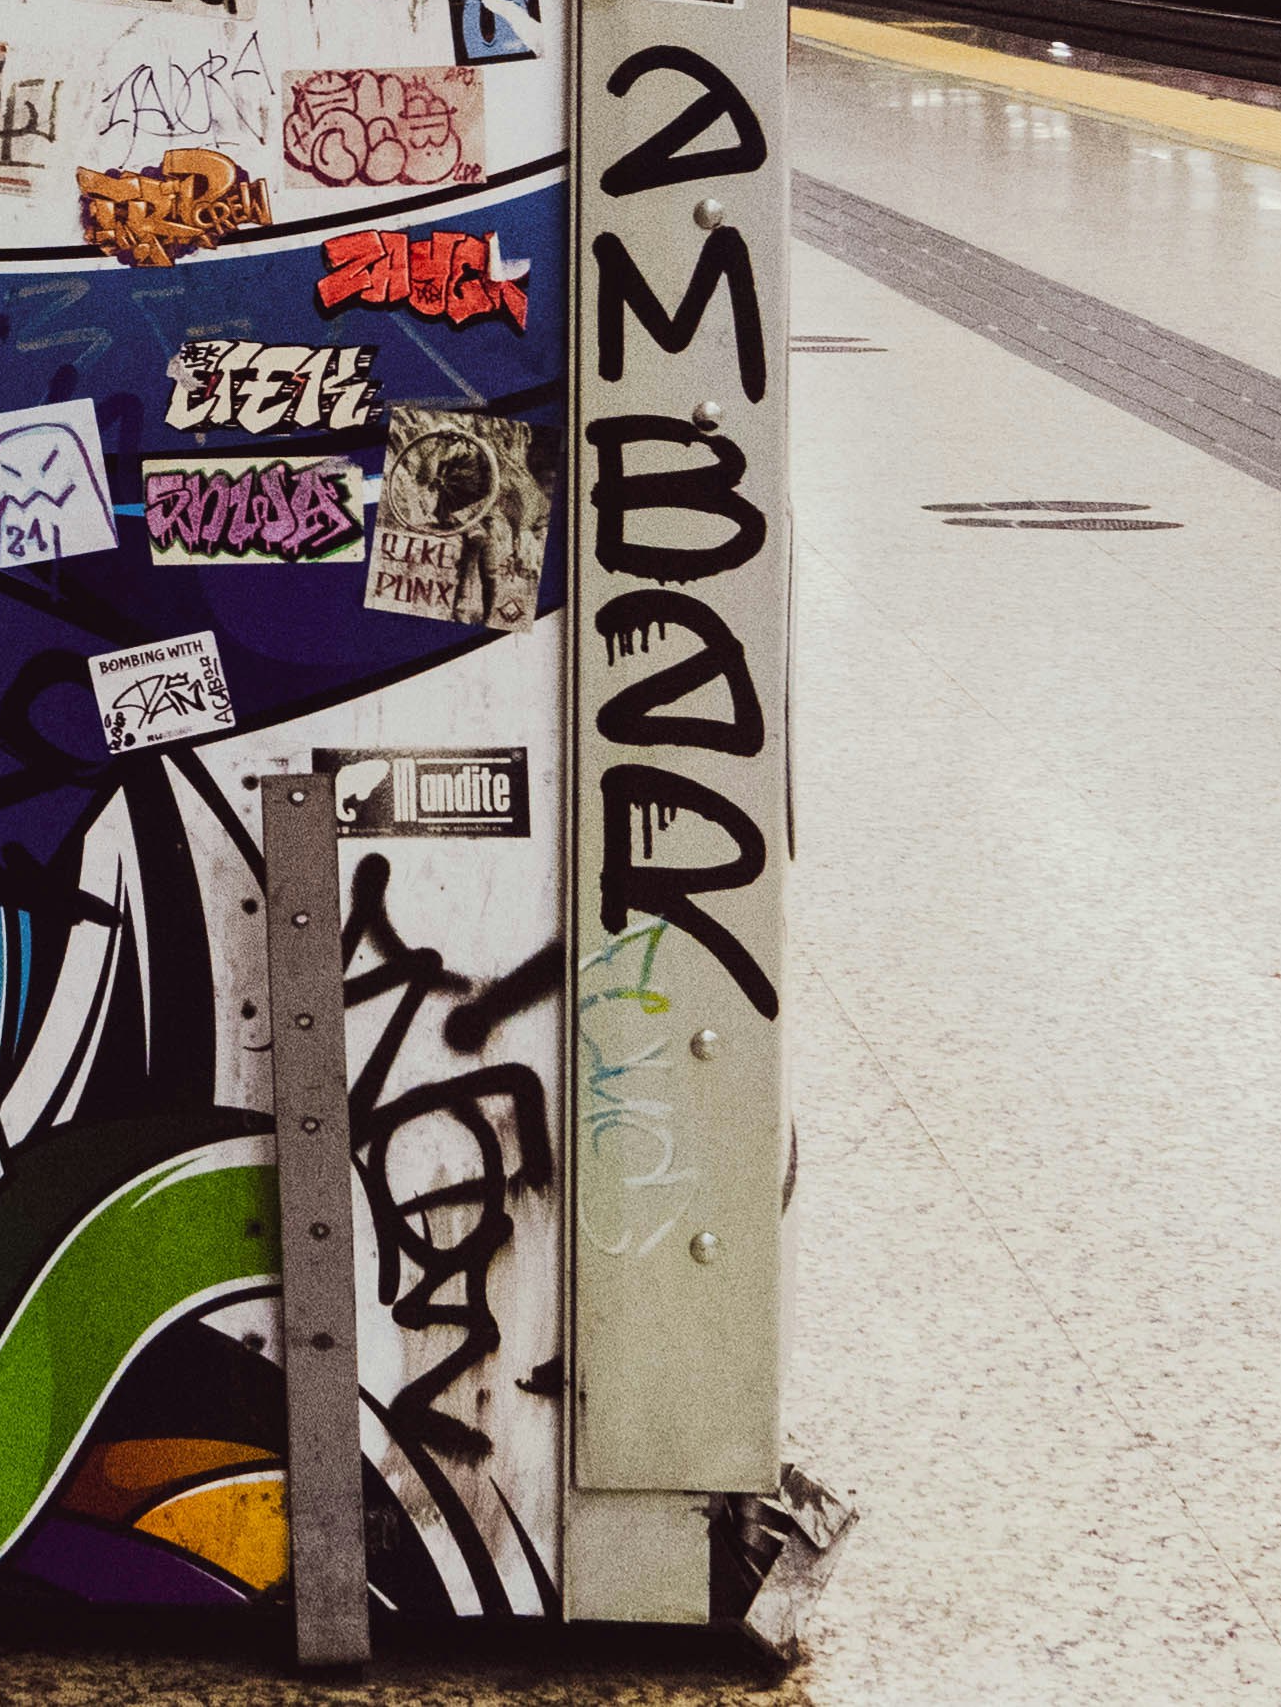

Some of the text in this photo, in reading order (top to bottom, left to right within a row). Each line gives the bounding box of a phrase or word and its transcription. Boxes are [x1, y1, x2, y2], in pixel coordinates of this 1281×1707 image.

[99, 639, 204, 675] BOMBING WITH
[393, 757, 511, 823] Mandite
